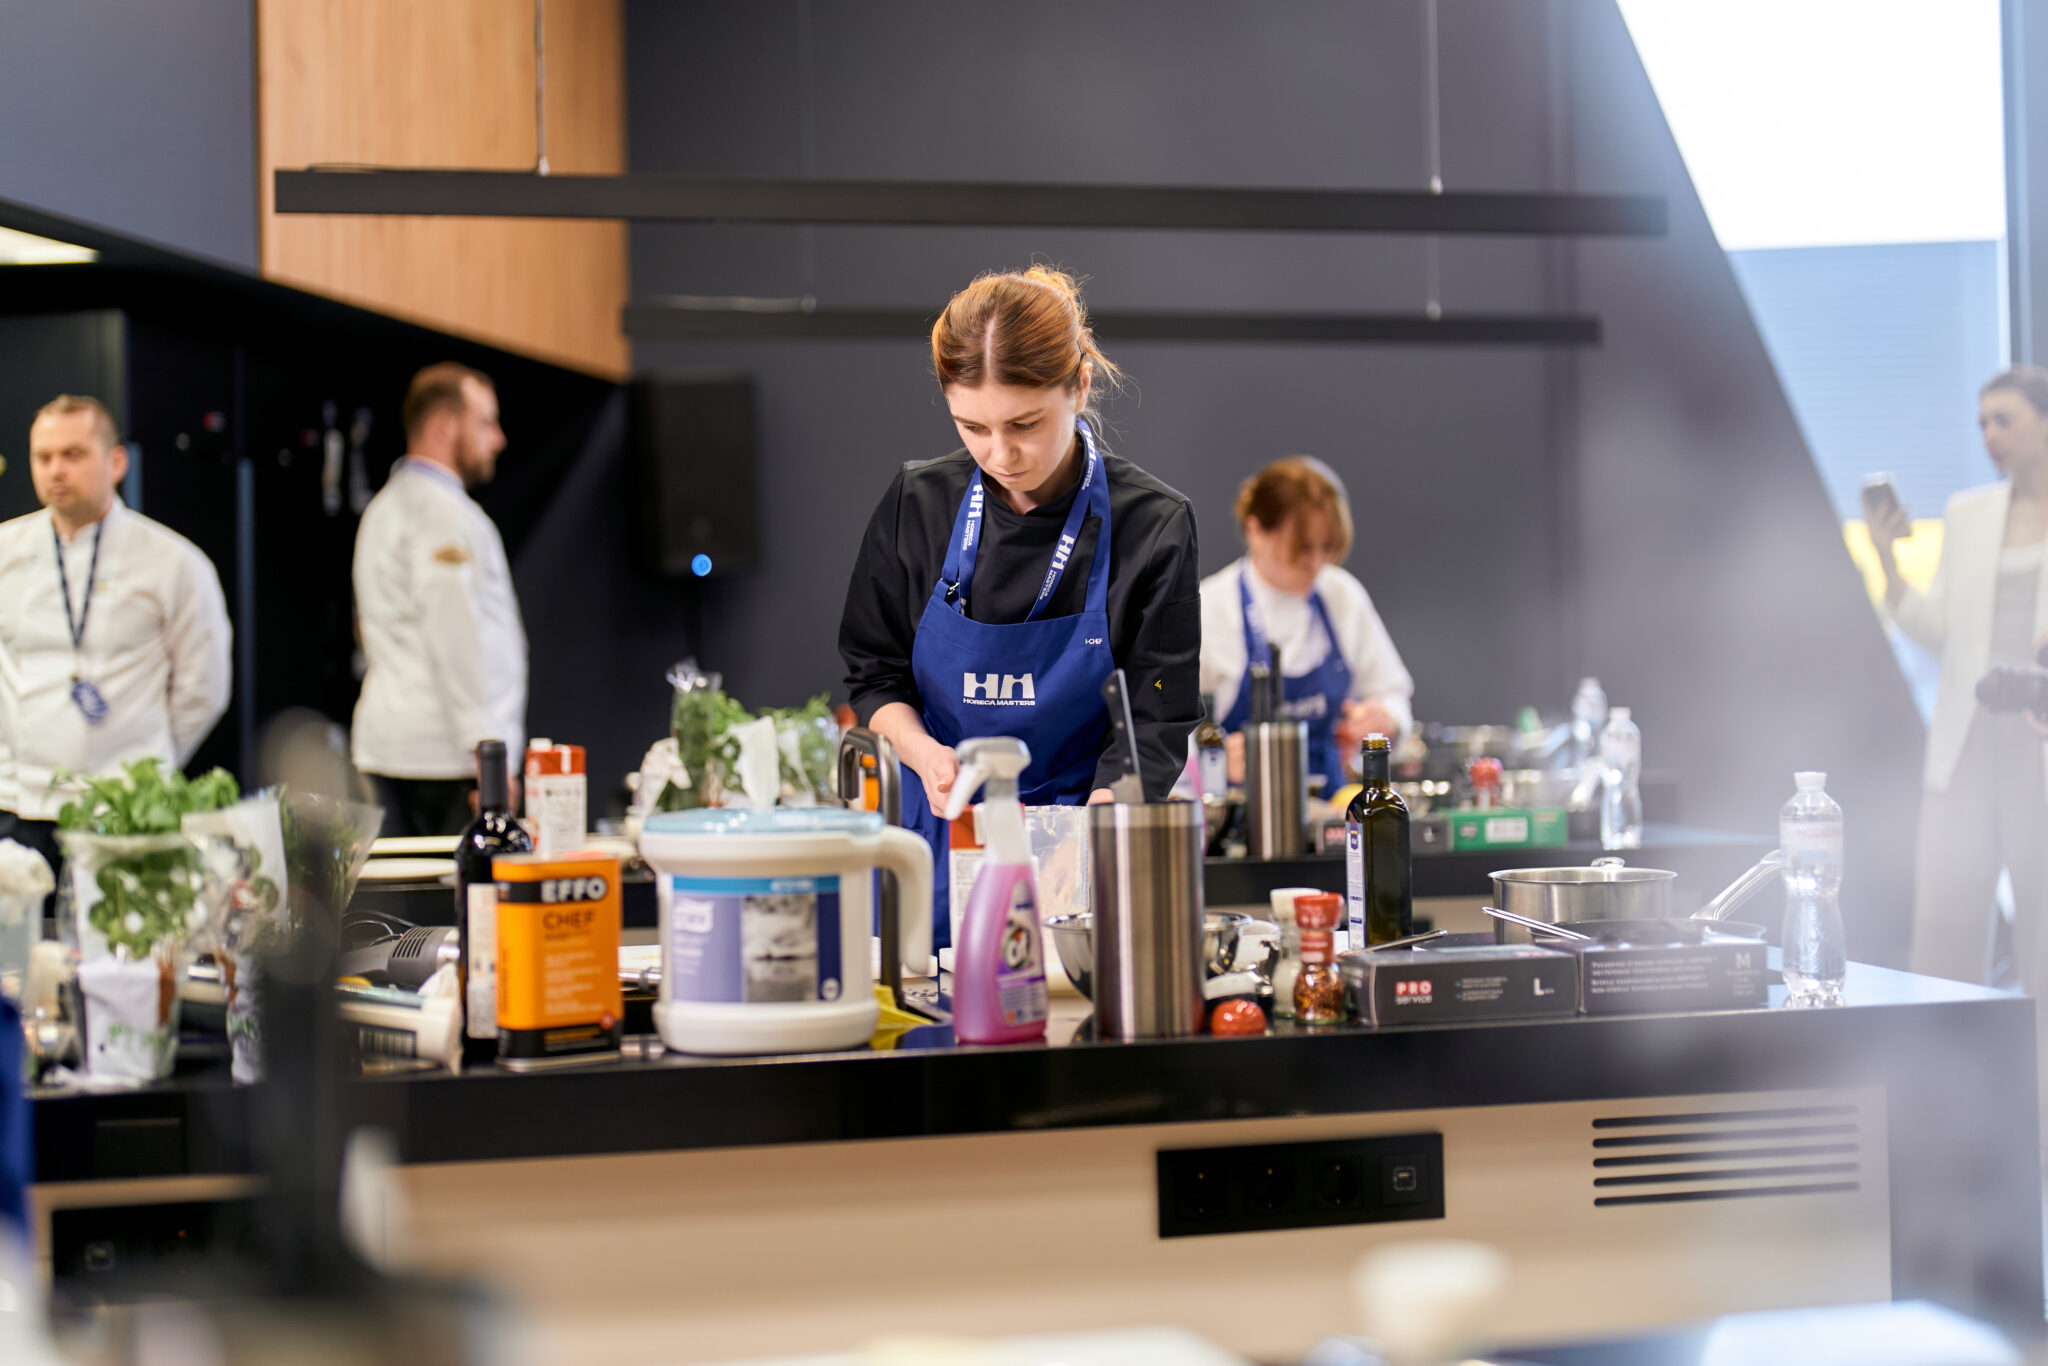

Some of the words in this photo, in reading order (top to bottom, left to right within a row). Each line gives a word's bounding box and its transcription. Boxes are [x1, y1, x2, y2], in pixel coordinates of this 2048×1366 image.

[963, 697, 996, 706] HORECA
[541, 876, 608, 904] EFFO
[542, 909, 596, 932] CHEF
[1735, 952, 1751, 969] M
[1396, 981, 1433, 996] PRO
[1395, 995, 1433, 1005] service
